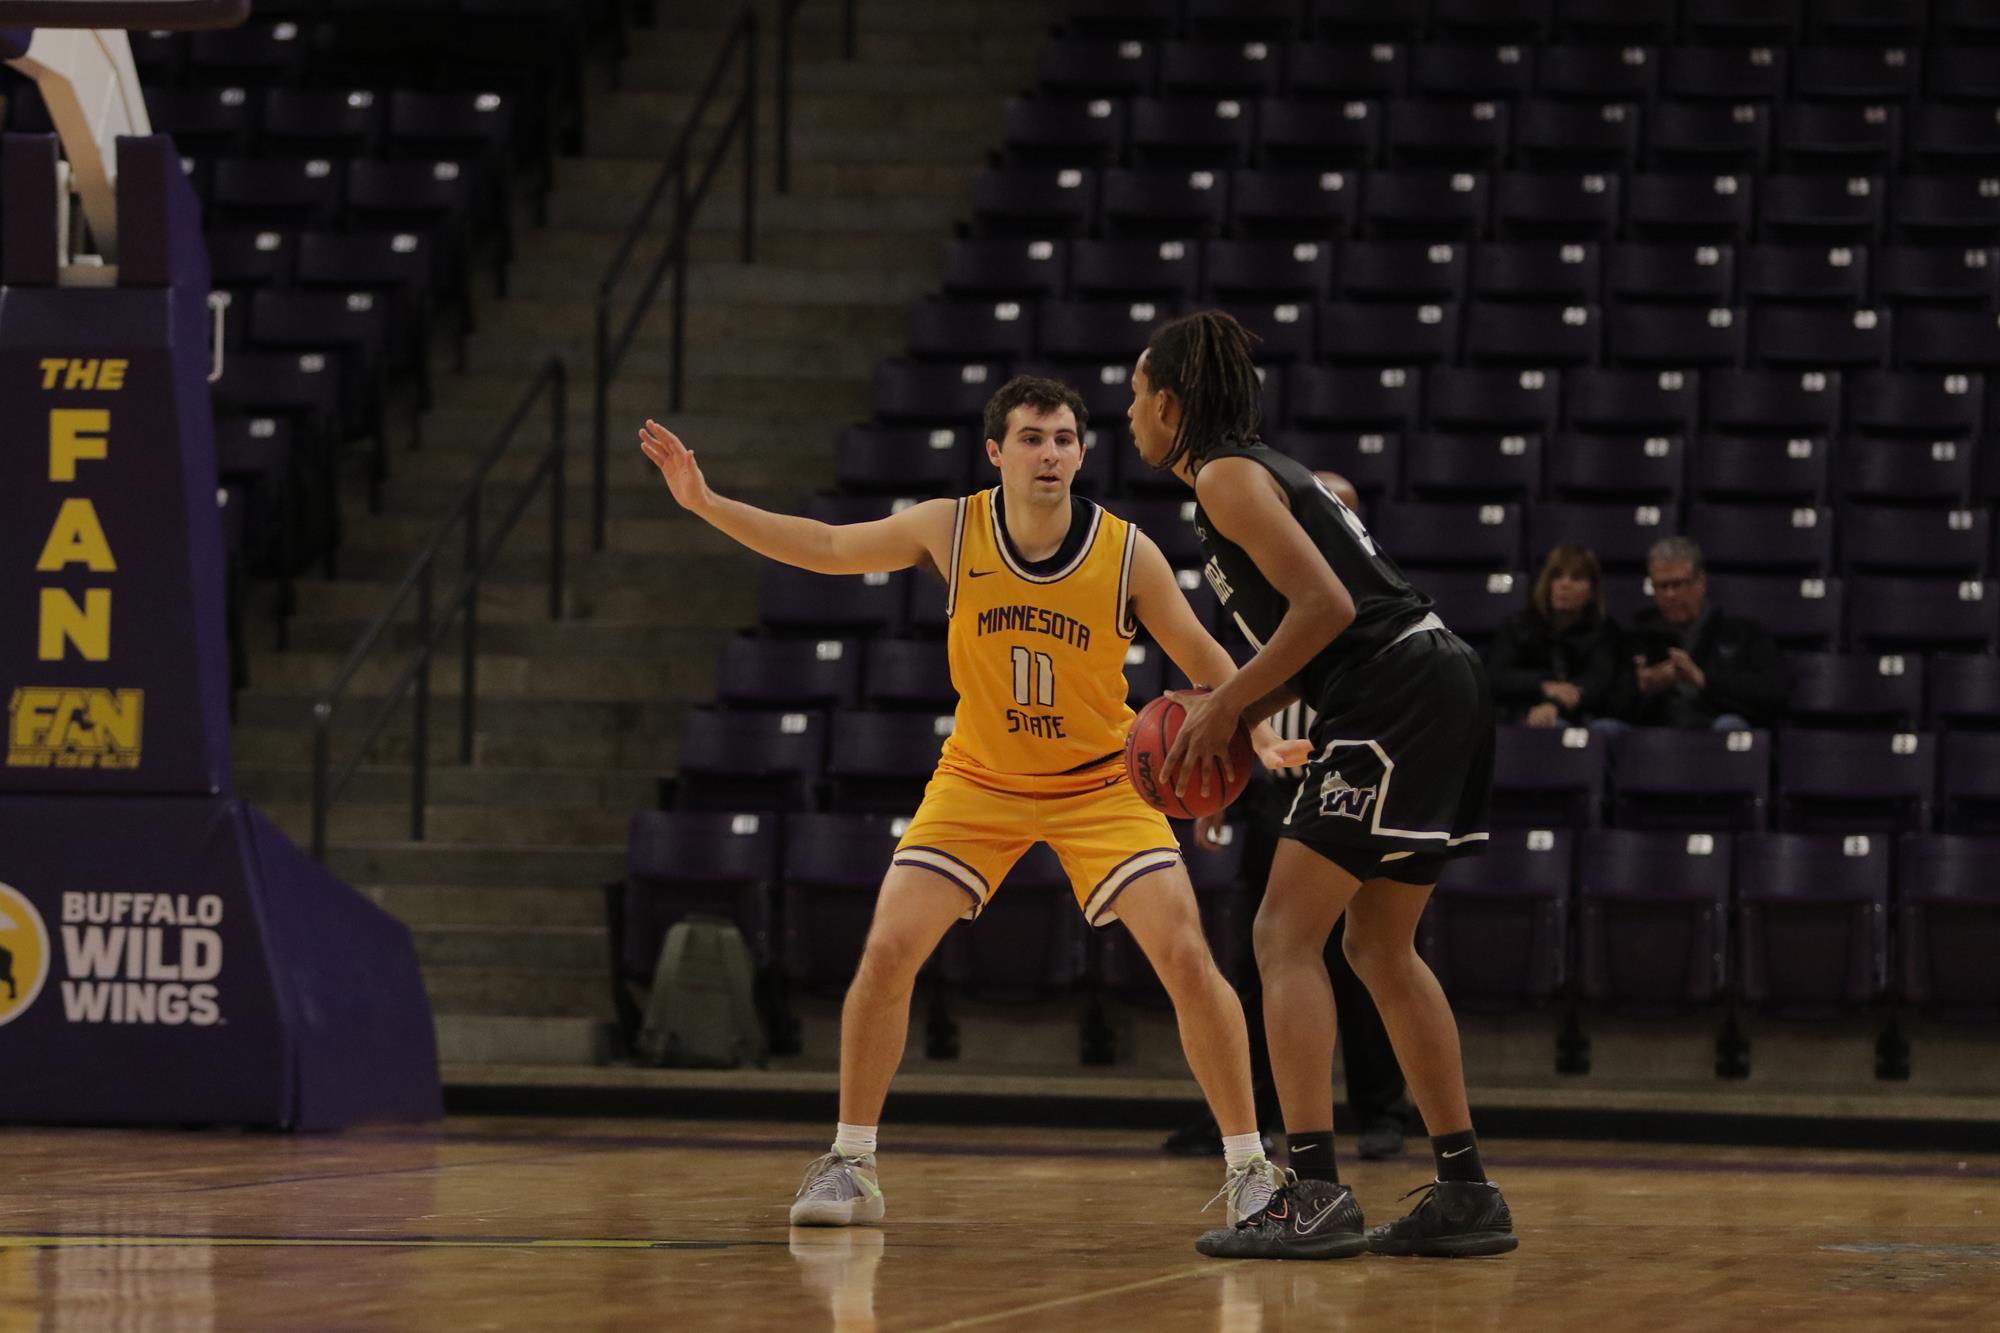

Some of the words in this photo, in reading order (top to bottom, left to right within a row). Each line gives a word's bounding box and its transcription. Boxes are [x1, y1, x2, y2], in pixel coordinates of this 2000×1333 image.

[40, 358, 129, 390] THE
[36, 409, 118, 662] FAN
[977, 605, 1091, 652] MINNESOTA
[1011, 646, 1055, 707] 11
[8, 686, 145, 753] FAN
[1006, 709, 1067, 739] STATE
[61, 890, 224, 927] BUFFALO
[61, 925, 224, 982] WILD
[61, 981, 221, 1026] WINGS
